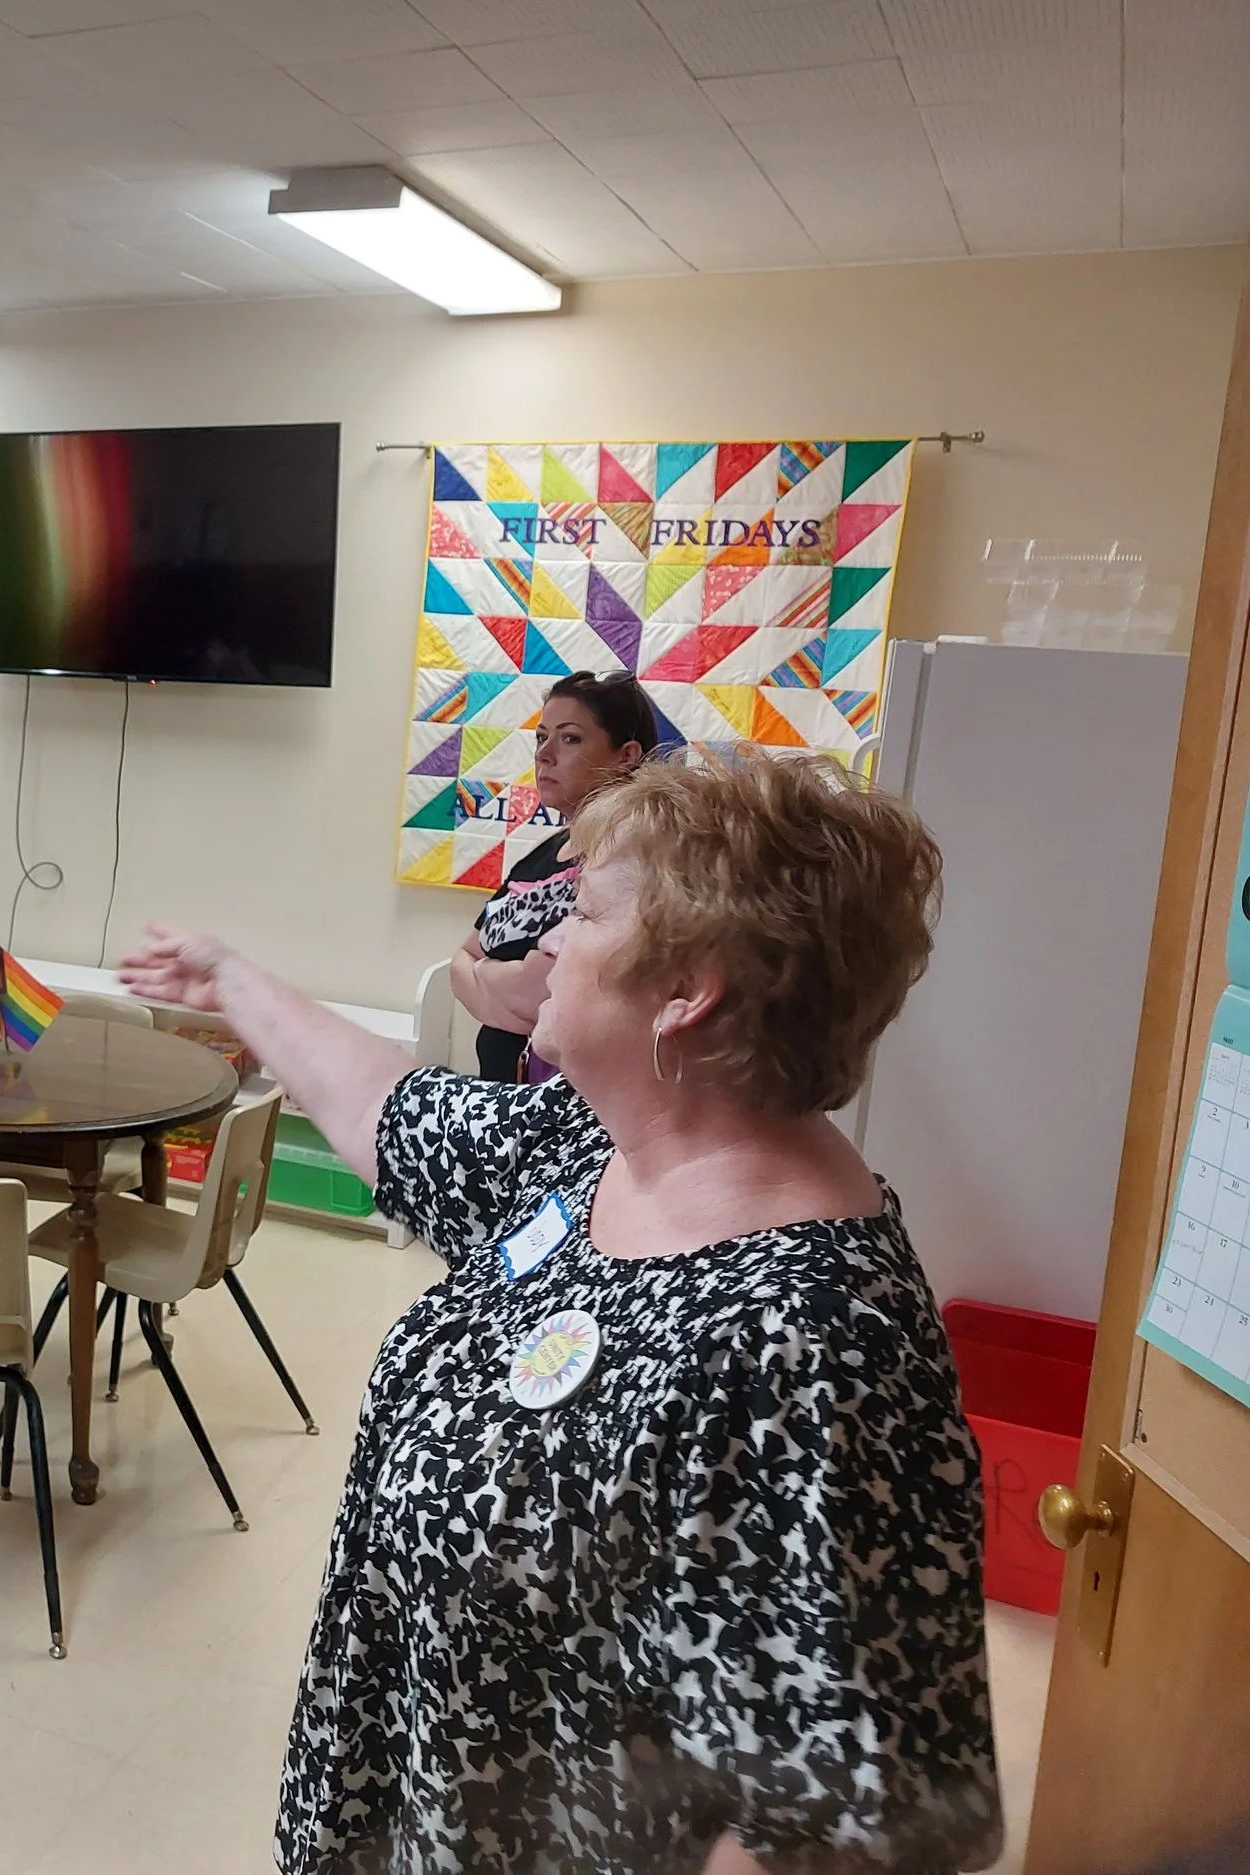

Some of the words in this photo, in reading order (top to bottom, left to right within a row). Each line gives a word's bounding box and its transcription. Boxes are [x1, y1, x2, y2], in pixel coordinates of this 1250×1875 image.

[500, 516, 607, 545] FIRST
[651, 518, 822, 548] FRIDAYS
[446, 794, 517, 822] ALL
[1172, 1276, 1182, 1287] 23
